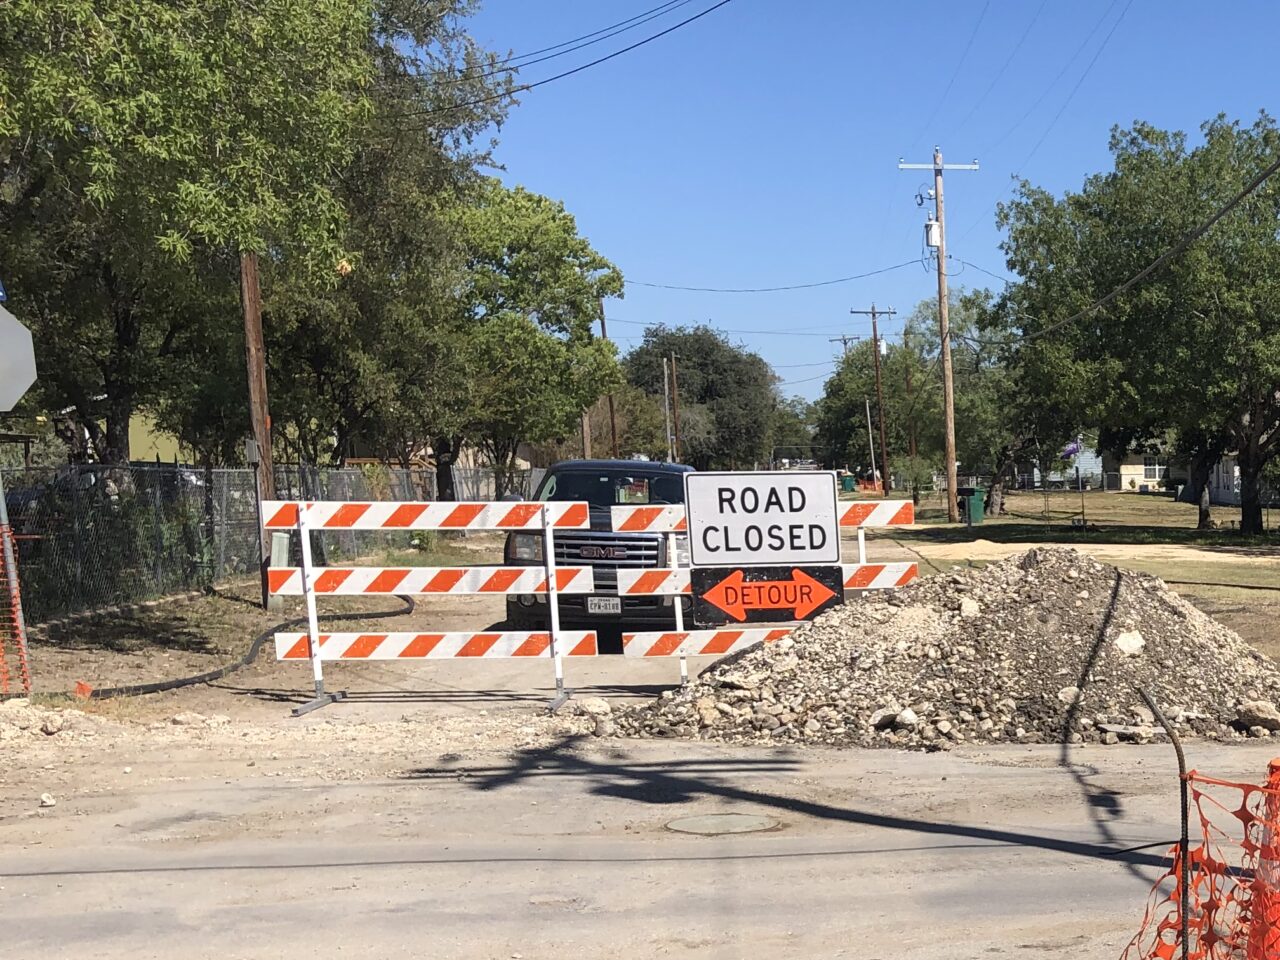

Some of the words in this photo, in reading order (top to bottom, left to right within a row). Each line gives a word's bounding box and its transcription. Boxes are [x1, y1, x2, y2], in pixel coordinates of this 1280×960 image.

[717, 486, 807, 514] ROAD
[702, 524, 827, 552] CLOSED
[580, 546, 627, 558] GMC
[724, 585, 813, 606] DETOUR
